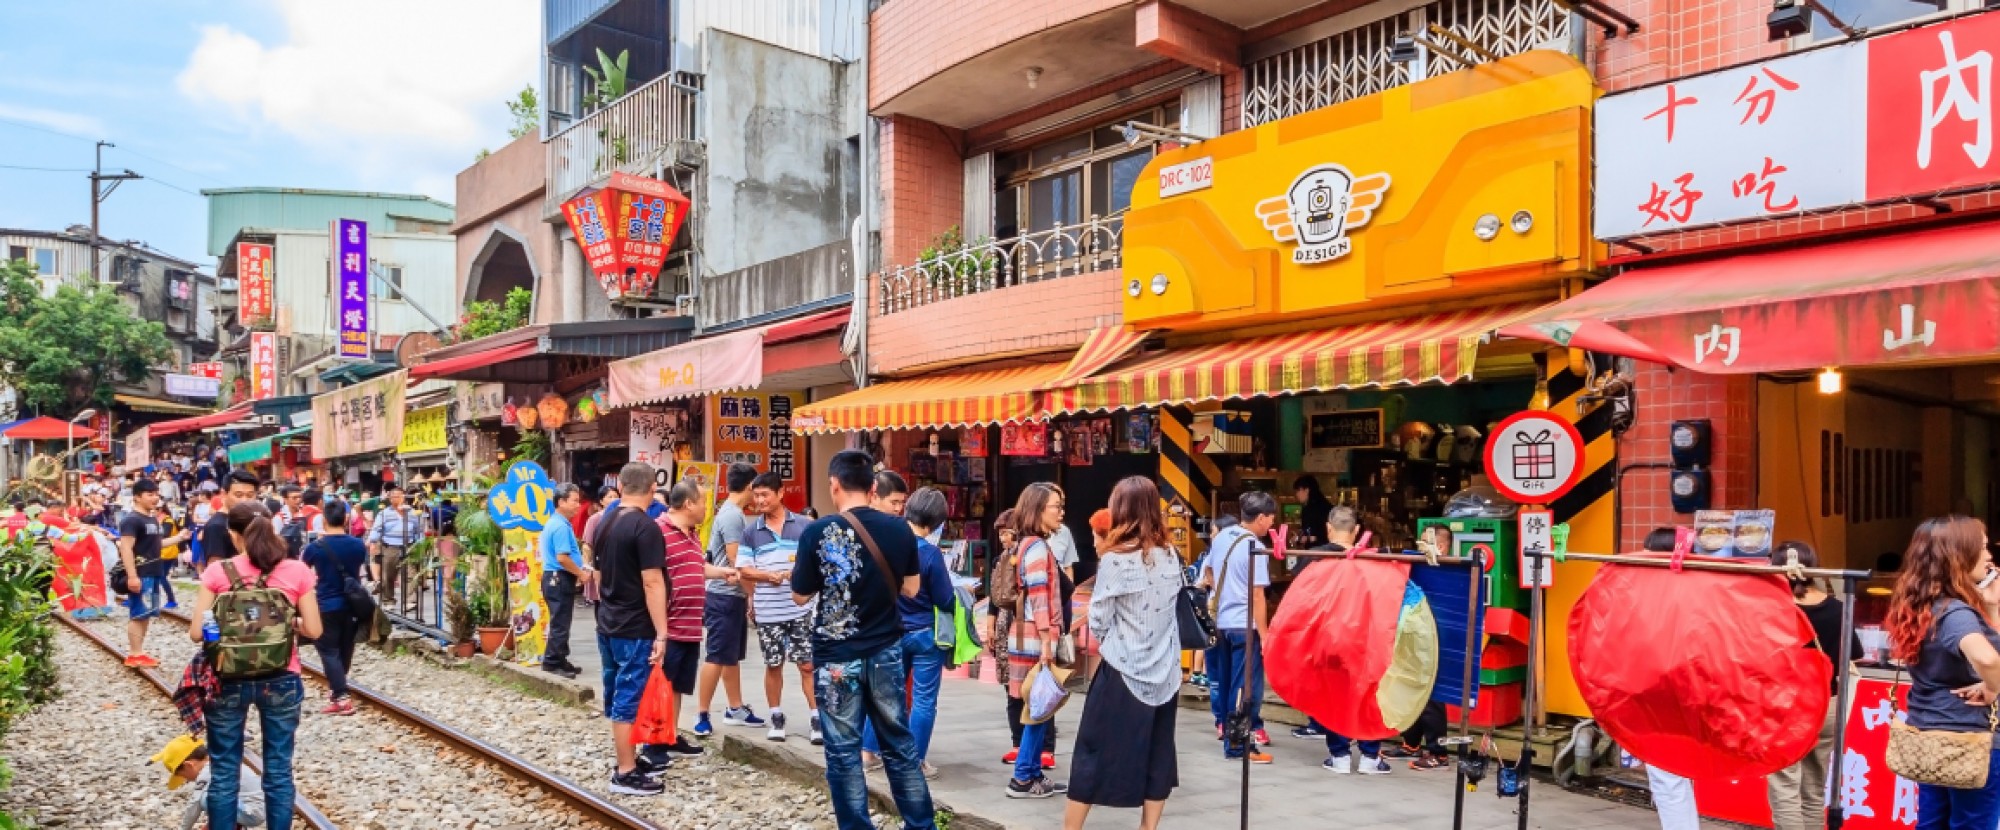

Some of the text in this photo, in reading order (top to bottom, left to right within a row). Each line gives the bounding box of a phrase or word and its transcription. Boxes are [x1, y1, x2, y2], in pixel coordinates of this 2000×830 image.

[1642, 67, 1799, 143] 十分
[1159, 163, 1211, 190] DRC-102
[1638, 157, 1799, 227] 好吃
[631, 195, 665, 222] 十分
[1296, 242, 1347, 261] DESIGN
[720, 396, 761, 418] 麻辣
[514, 467, 537, 481] Mr
